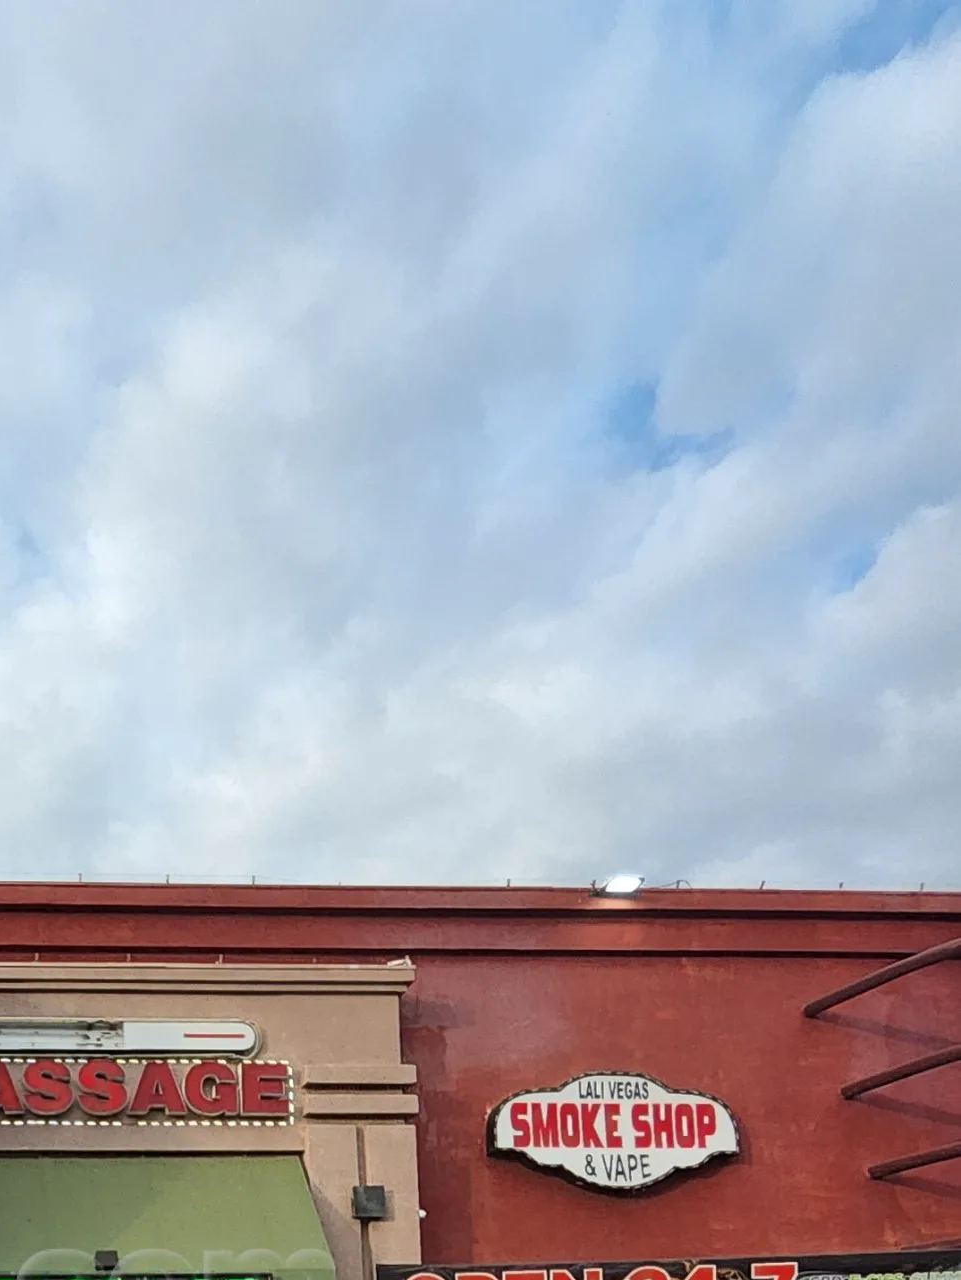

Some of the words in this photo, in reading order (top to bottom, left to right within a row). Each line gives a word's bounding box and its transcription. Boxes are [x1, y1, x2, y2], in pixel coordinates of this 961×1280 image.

[579, 1081, 604, 1099] LALI
[609, 1081, 649, 1100] VEGAS
[510, 1103, 623, 1148] SMOKE
[631, 1103, 716, 1148] SHOP
[585, 1154, 597, 1177] &
[602, 1154, 651, 1182] VAPE
